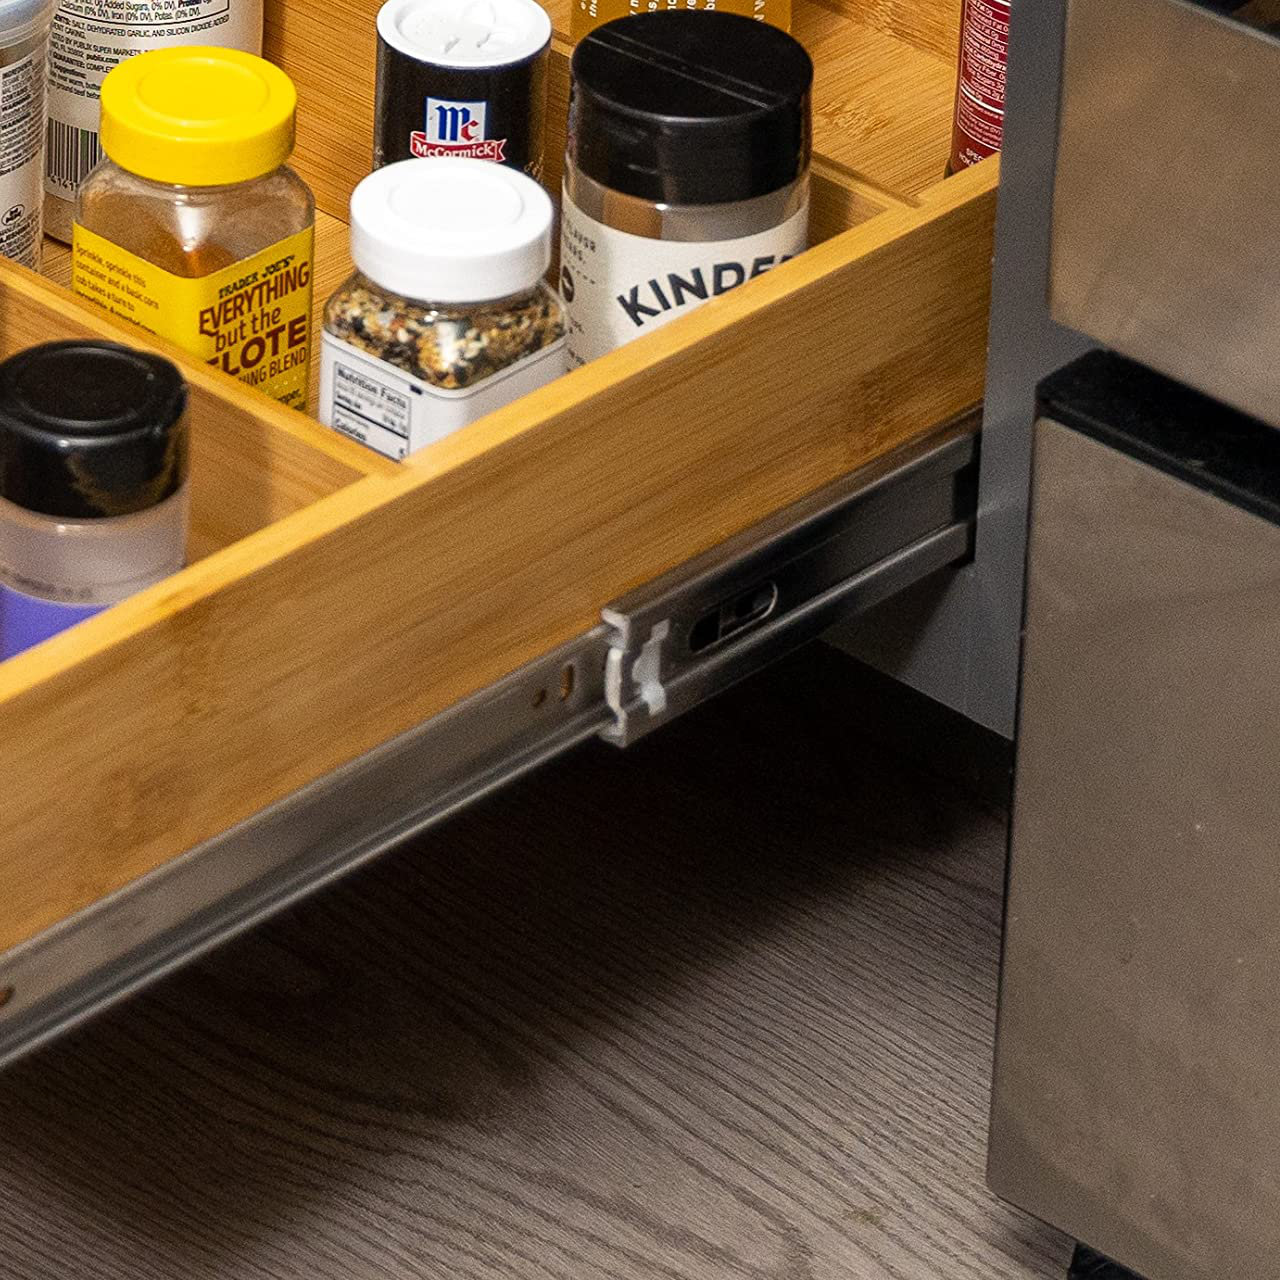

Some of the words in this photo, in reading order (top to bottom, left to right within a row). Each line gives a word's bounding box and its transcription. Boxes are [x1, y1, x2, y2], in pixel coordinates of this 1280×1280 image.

[151, 28, 166, 37] AND
[166, 27, 190, 36] SILICON
[414, 141, 496, 159] McCormick
[199, 261, 310, 336] EVERYTHING
[218, 273, 258, 299] TRADER
[617, 254, 795, 327] KINDE
[251, 306, 281, 334] the
[207, 314, 307, 376] LOTE
[269, 347, 306, 378] BLEND
[380, 387, 407, 409] Facts
